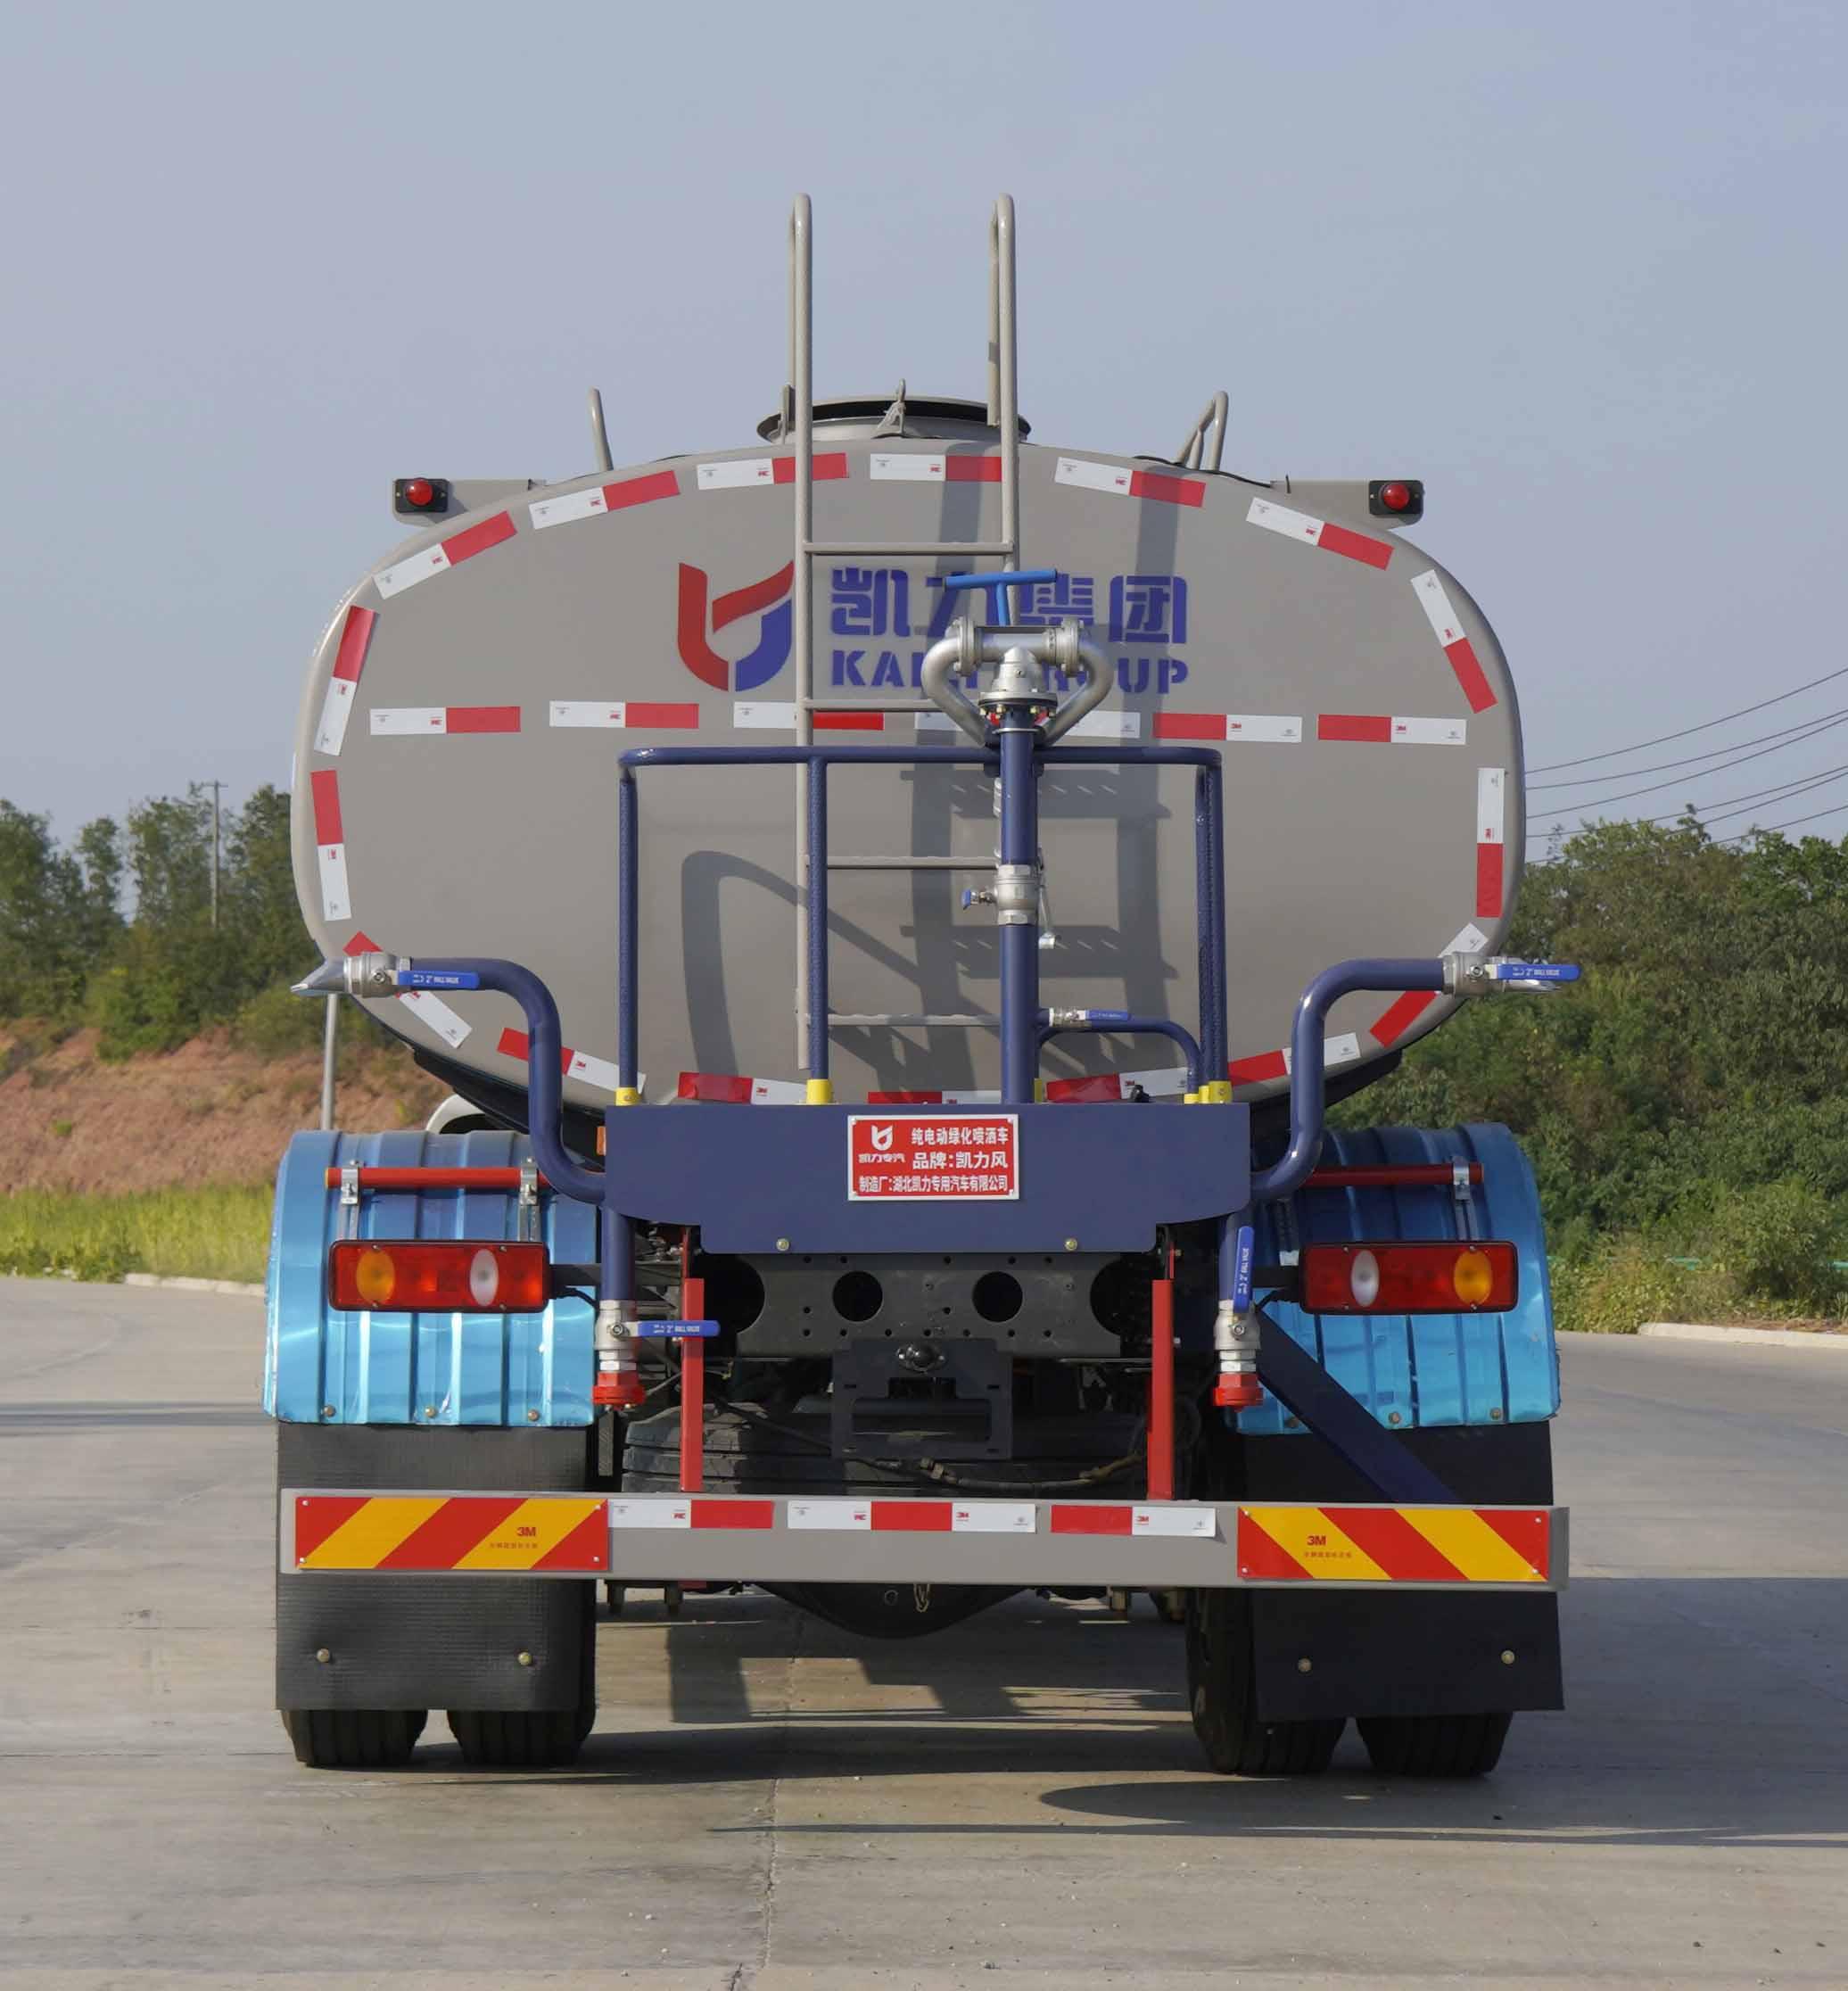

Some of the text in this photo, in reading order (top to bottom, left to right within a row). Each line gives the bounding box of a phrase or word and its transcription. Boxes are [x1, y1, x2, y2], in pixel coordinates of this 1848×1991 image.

[912, 1127, 1009, 1145] 纯电动绿化喷洒车
[912, 1151, 1009, 1169] 品牌：凯力风
[516, 1526, 536, 1537] 3M
[1307, 1535, 1327, 1546] 3M
